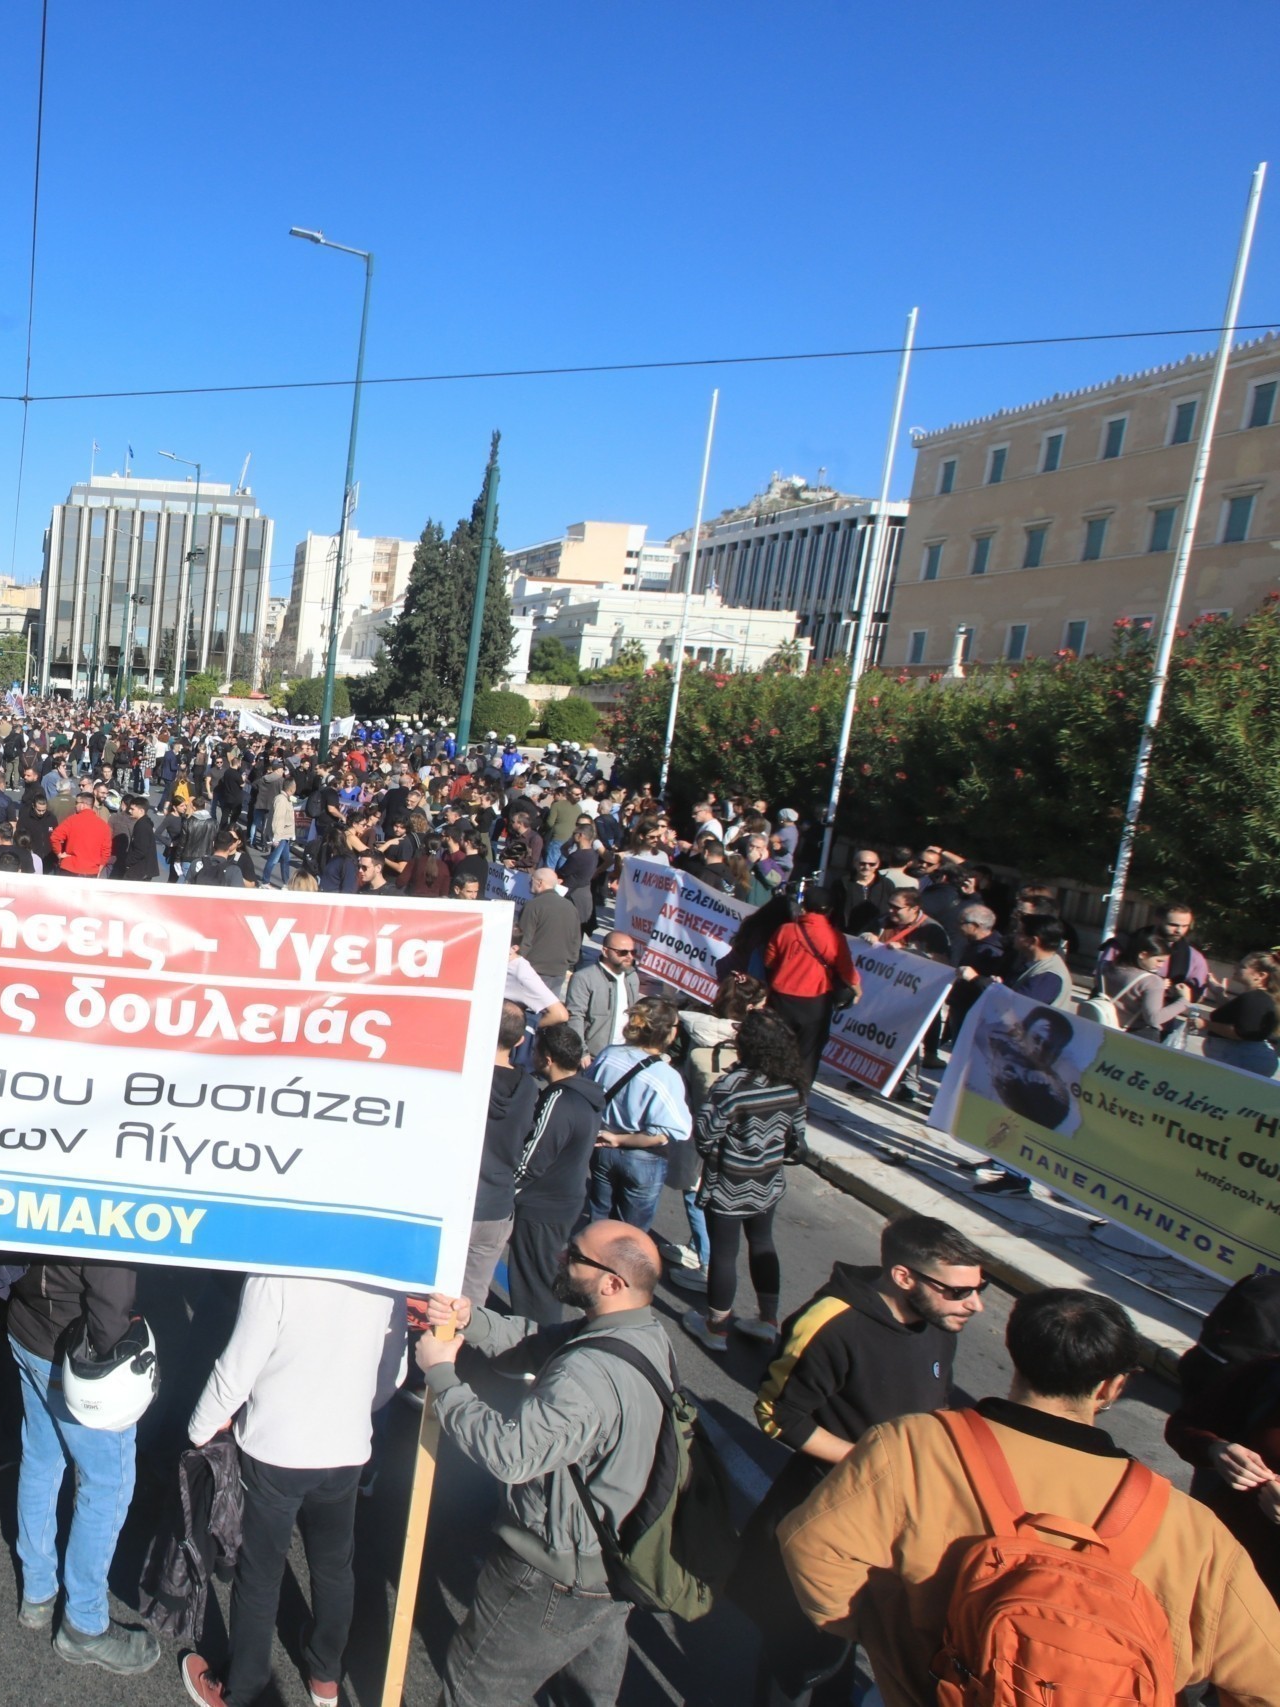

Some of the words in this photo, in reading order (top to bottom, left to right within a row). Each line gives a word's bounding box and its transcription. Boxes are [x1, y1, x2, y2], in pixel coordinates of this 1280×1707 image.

[632, 869, 641, 883] Η
[196, 939, 218, 952] -
[245, 915, 444, 981] Υγεία
[650, 928, 707, 962] αναφορά
[660, 903, 729, 941] ΑΥΞΗΣΕΙΣ
[640, 951, 681, 984] ΕΛΕΣΤΩΝ
[681, 972, 720, 1000] ΜΟΥΣΙΚ
[855, 954, 897, 979] κοινό
[893, 973, 922, 994] μας
[65, 976, 391, 1059] δουλειάς
[843, 1018, 898, 1049] μισθού
[124, 1076, 404, 1128] θυσιάζει
[1095, 1060, 1124, 1081] Μα
[1126, 1070, 1150, 1091] δε
[1152, 1081, 1178, 1103] θα
[1178, 1090, 1228, 1121] λένε:
[116, 1121, 303, 1175] λίγων
[1071, 1082, 1093, 1105] Θα
[1098, 1092, 1144, 1126] λένε:
[1237, 1151, 1280, 1182] σω
[1020, 1144, 1235, 1265] ΠΑΝΕΛΛΗΝΙΟΣ
